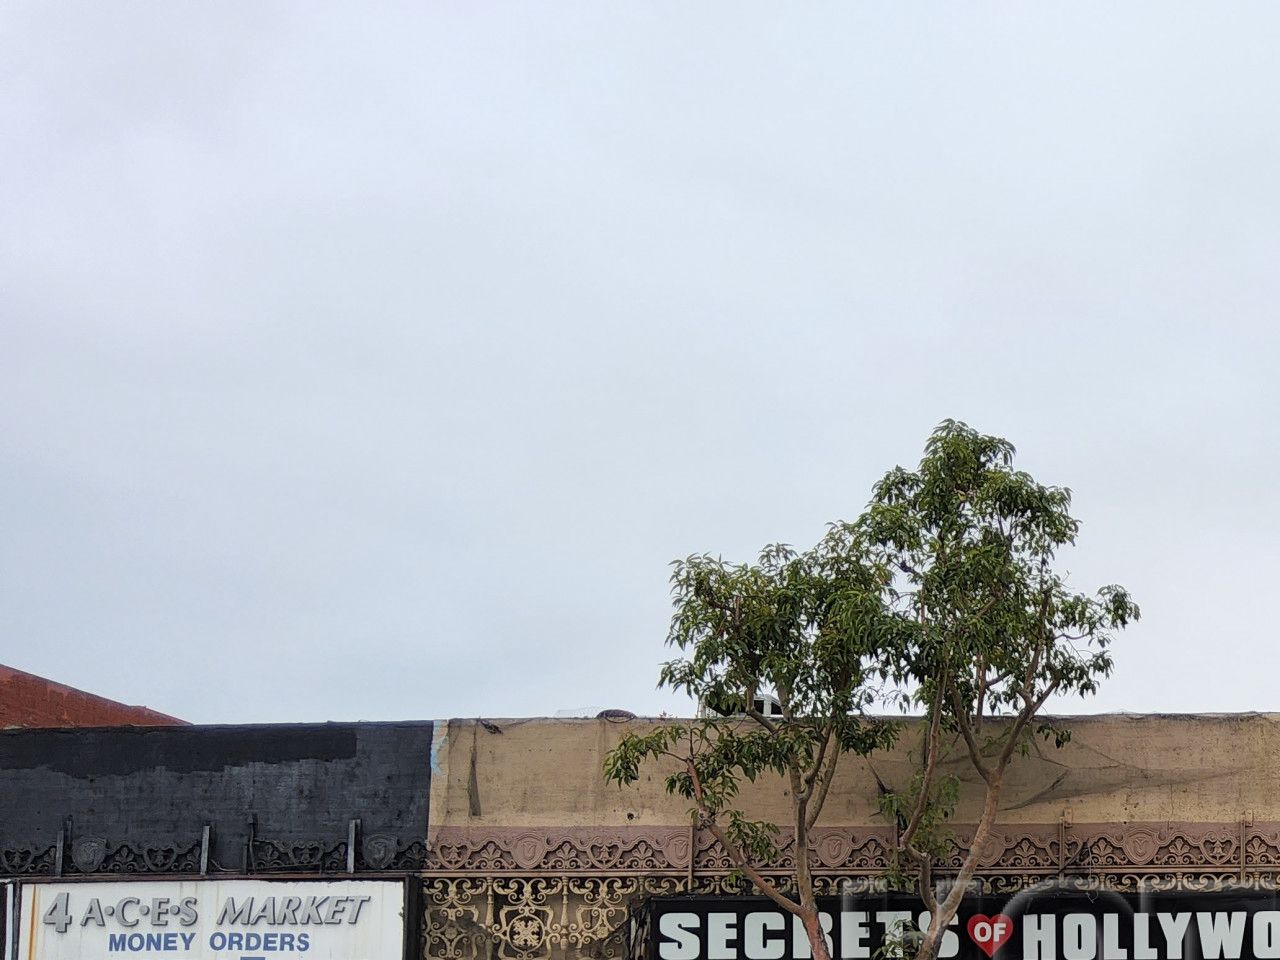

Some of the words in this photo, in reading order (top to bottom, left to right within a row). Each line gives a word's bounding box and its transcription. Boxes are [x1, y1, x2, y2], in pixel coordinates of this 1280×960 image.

[42, 892, 72, 933] 4
[216, 895, 371, 925] MARKET
[108, 932, 196, 951] MONEY
[209, 932, 310, 951] ORDERS
[974, 922, 1007, 943] OF
